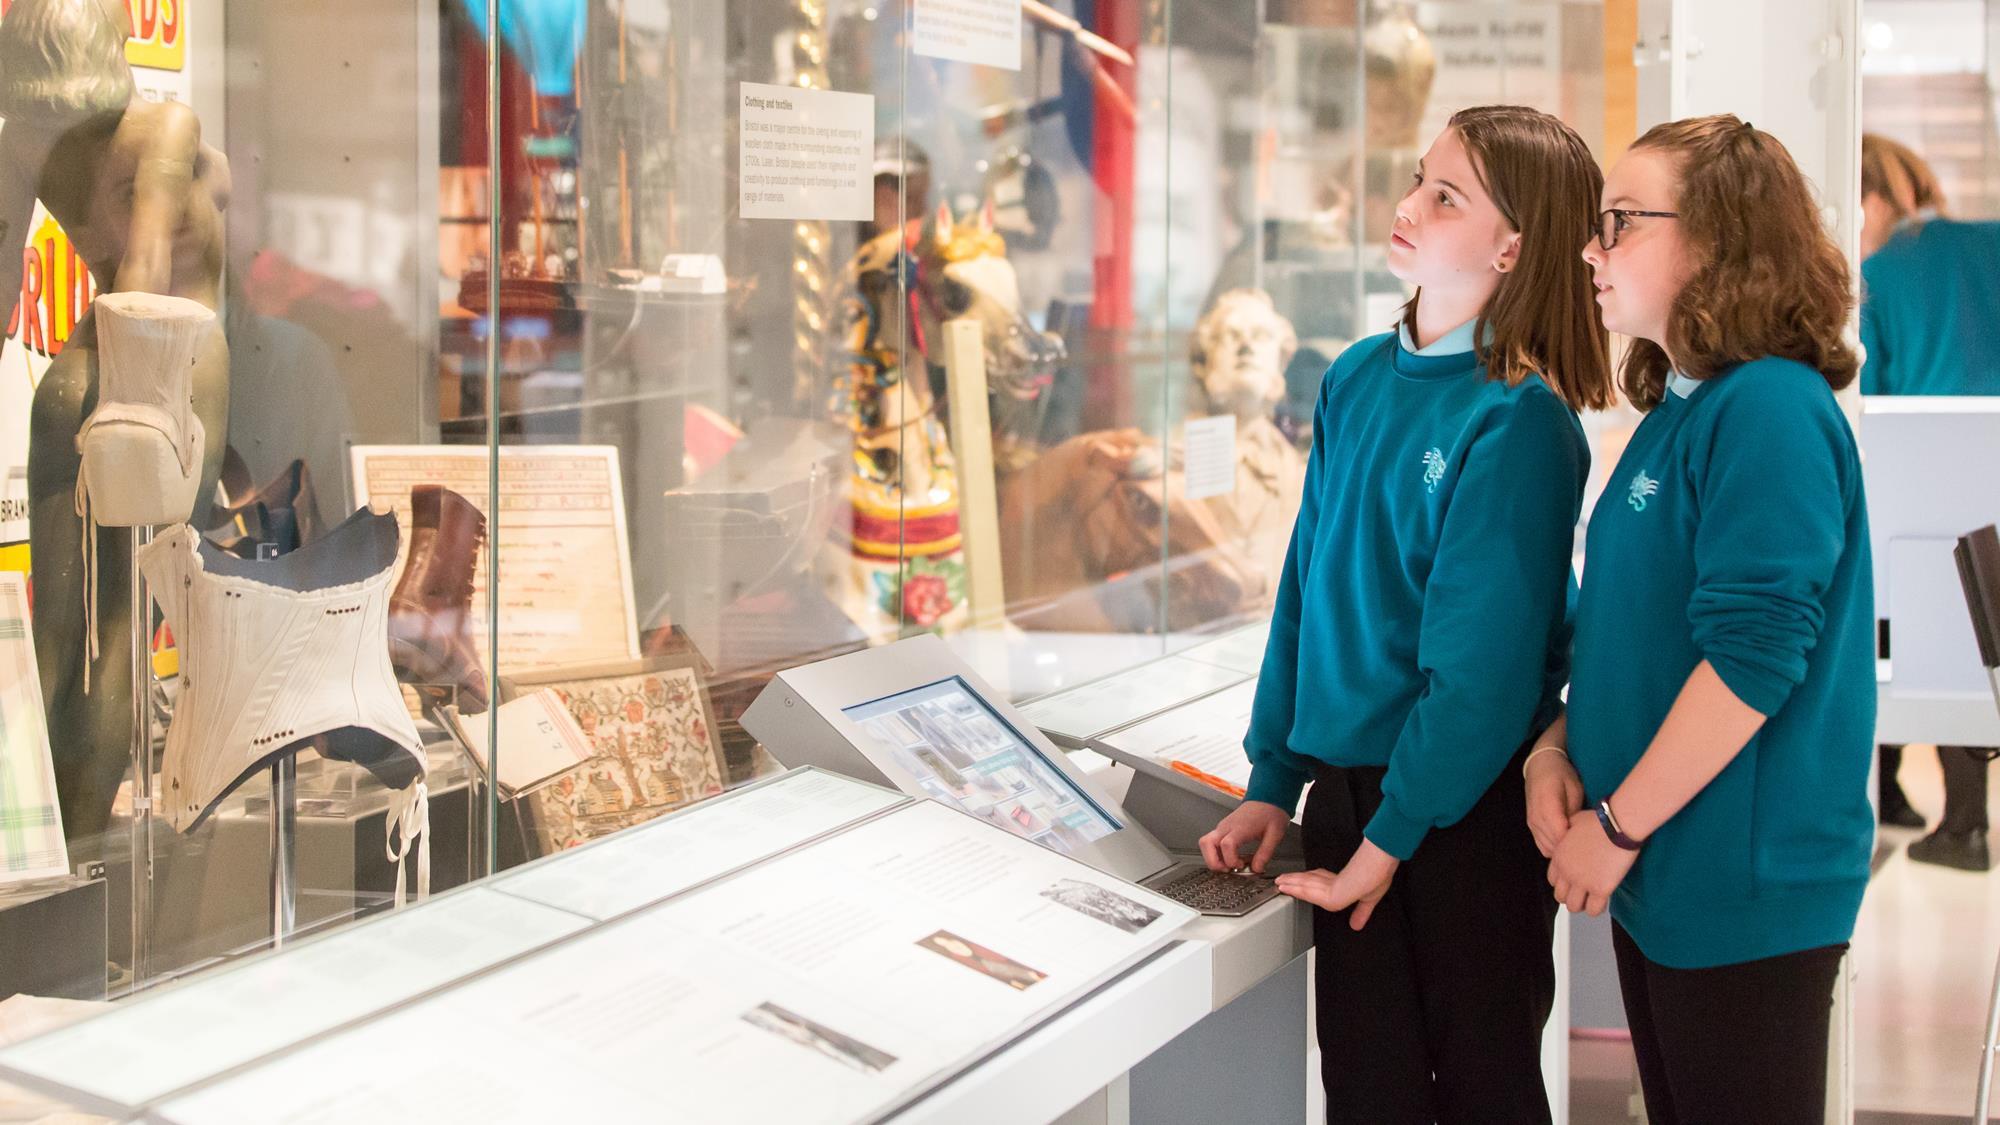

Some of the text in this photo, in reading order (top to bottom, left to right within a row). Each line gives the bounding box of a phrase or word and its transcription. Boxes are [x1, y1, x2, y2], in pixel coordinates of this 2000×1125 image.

[744, 95, 793, 110] Clothing and textiles
[744, 119, 760, 132] Bristol
[760, 123, 769, 132] was
[773, 124, 786, 135] major
[786, 125, 801, 135] centre
[774, 140, 786, 151] made
[775, 156, 790, 168] Bristol
[790, 159, 806, 170] people
[771, 176, 789, 187] produce
[744, 192, 758, 204] range
[758, 191, 764, 202] of
[1, 498, 30, 522] BRAN
